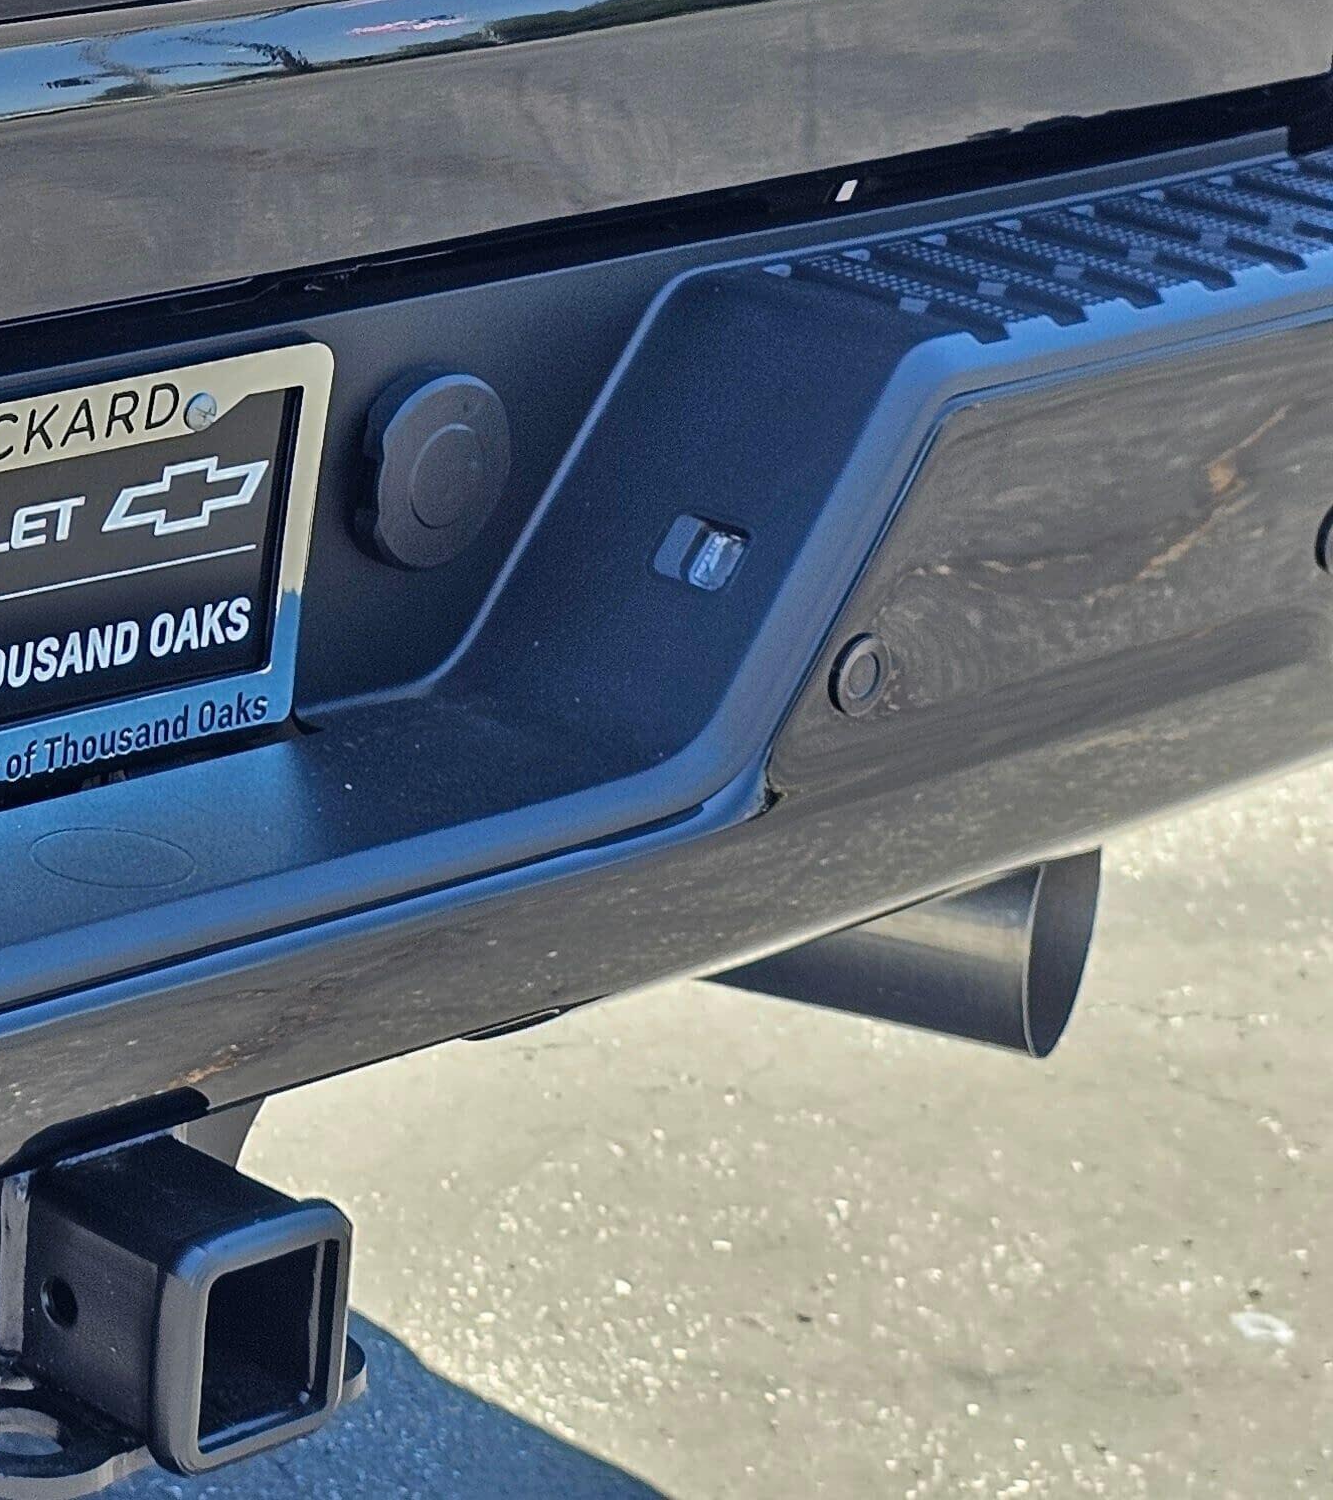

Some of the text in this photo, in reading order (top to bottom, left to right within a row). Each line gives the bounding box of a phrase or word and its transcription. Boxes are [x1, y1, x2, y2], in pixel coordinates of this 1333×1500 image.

[149, 596, 252, 658] OAKS
[5, 739, 38, 779] of
[43, 704, 190, 773] Thousand
[197, 691, 269, 732] Oaks
